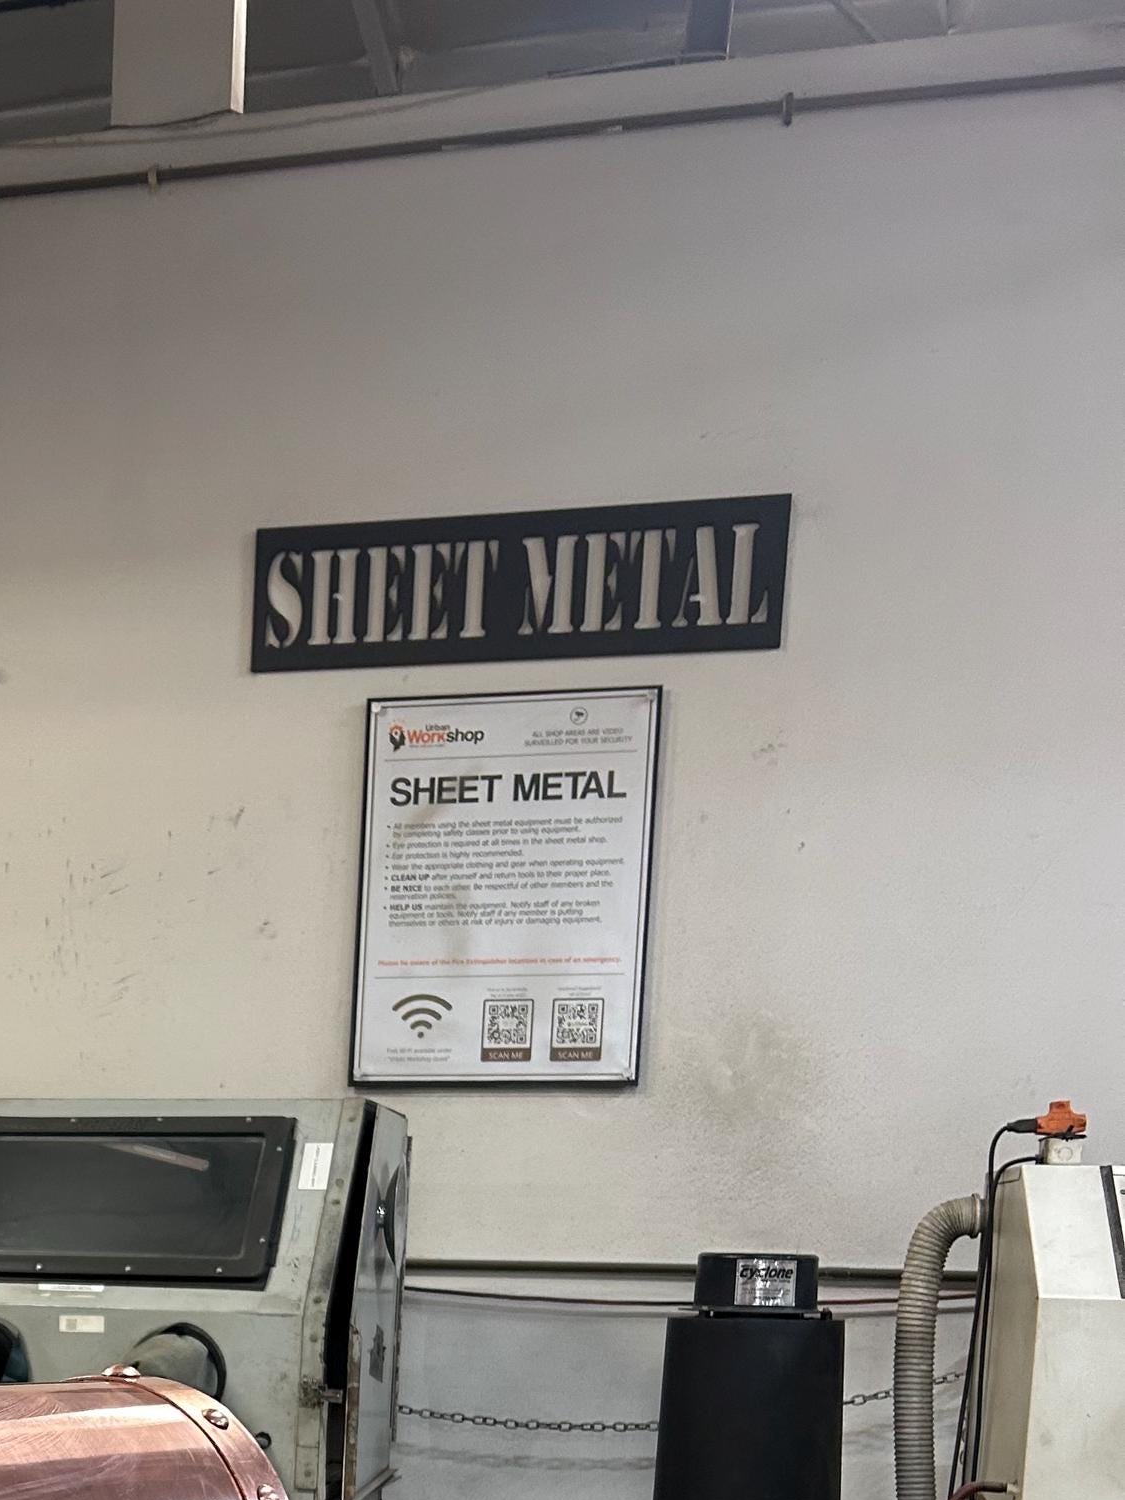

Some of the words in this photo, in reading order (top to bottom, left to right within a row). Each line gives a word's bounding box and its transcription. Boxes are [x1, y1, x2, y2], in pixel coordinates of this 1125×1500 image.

[264, 539, 499, 649] SHEET
[517, 523, 769, 636] METAL
[407, 728, 484, 744] Workshop
[390, 775, 502, 806] SHEET
[513, 771, 626, 801] METAL
[515, 818, 552, 826] equipment
[443, 829, 463, 837] safety
[492, 828, 508, 836] prior
[521, 827, 539, 835] using
[407, 840, 441, 849] protection
[589, 836, 608, 844] shop.
[406, 852, 439, 860] protection
[450, 851, 469, 859] highly
[425, 862, 463, 871] appropriate
[466, 861, 493, 870] clothing
[550, 859, 583, 867] operating
[450, 872, 476, 881] yourself
[565, 870, 588, 878] proper
[590, 869, 611, 877] place.
[485, 882, 519, 891] respectful
[561, 900, 573, 908] any
[389, 912, 425, 920] equipment
[458, 910, 478, 918] Notify
[558, 908, 583, 916] putting
[495, 917, 513, 925] injury
[489, 1052, 508, 1060] SCAN
[558, 1051, 579, 1059] SCAN
[740, 1266, 793, 1279] cyclone
